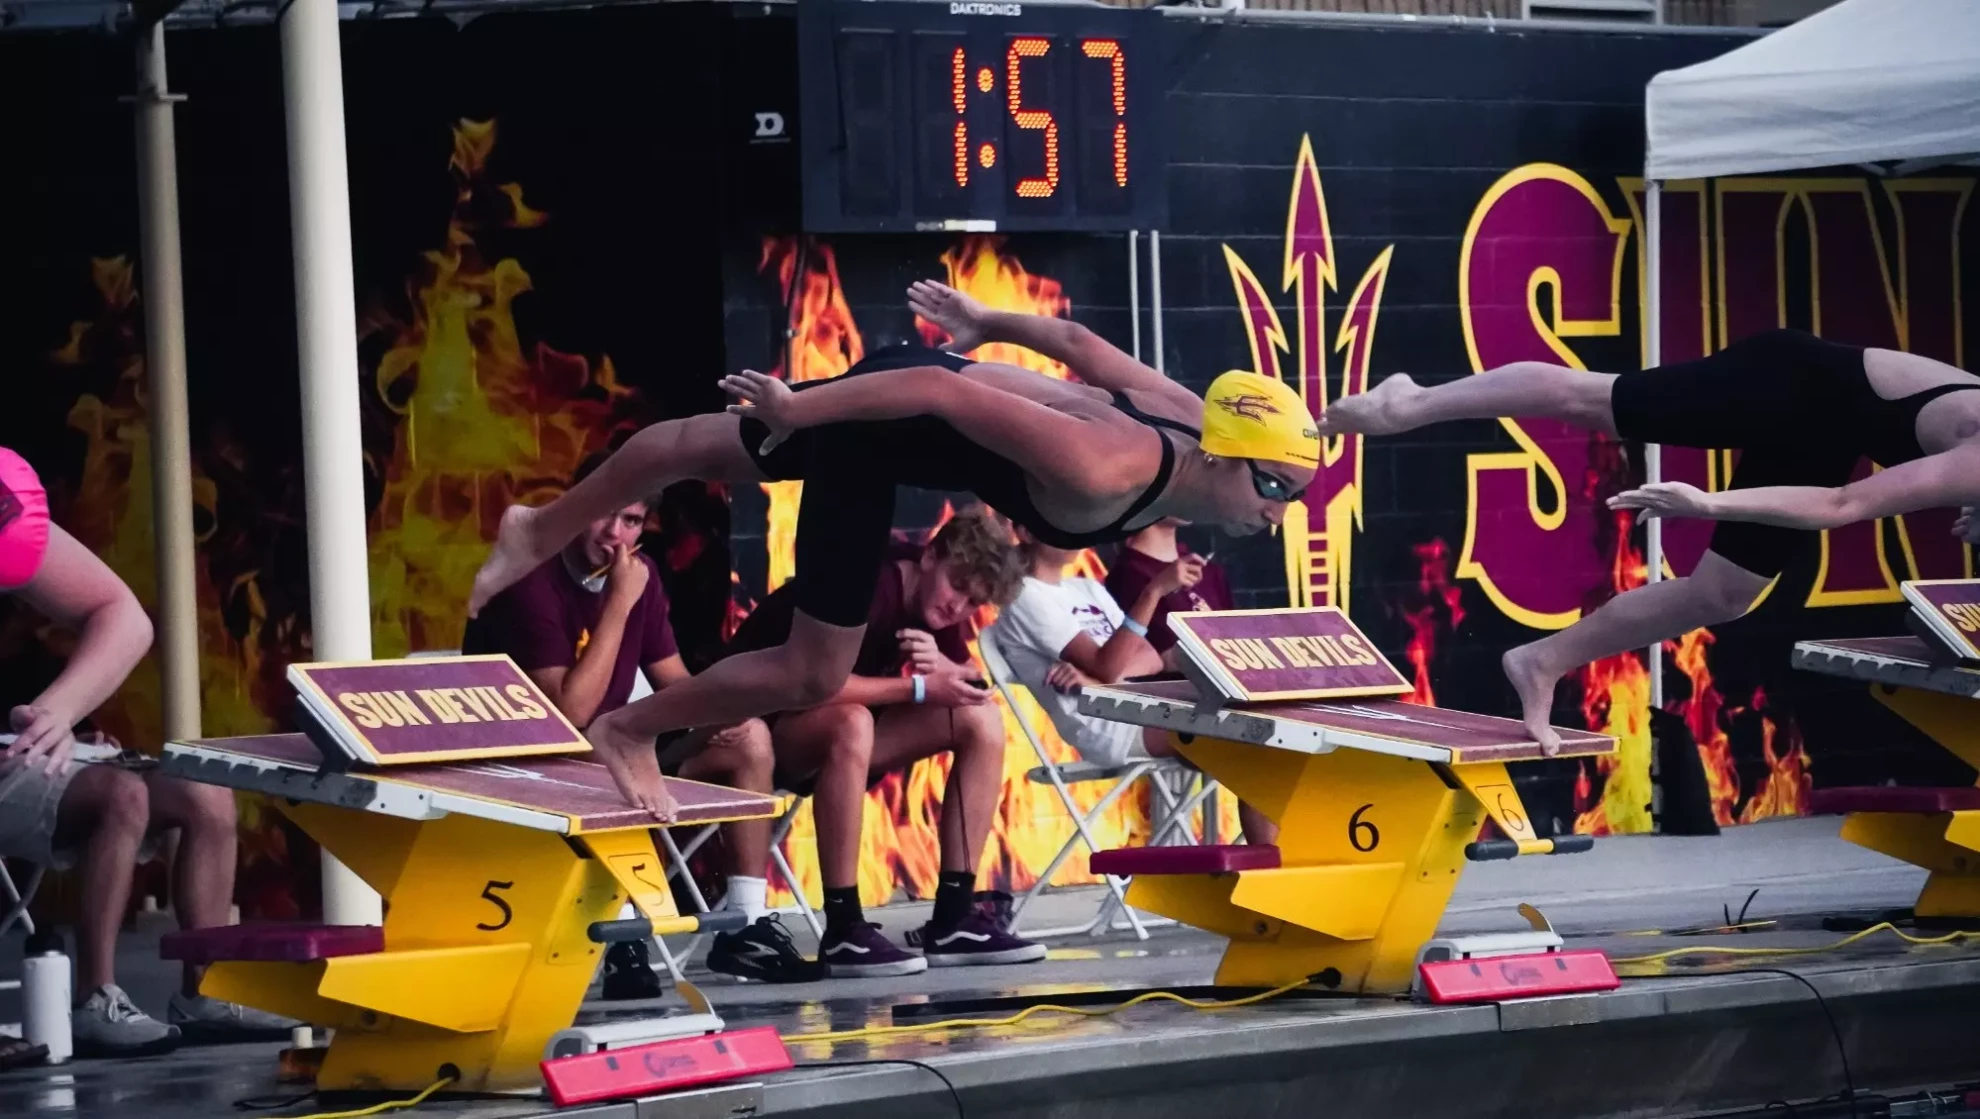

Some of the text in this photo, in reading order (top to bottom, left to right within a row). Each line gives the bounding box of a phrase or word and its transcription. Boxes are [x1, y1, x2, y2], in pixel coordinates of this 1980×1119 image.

[950, 2, 1021, 16] DAKTRONICS
[953, 39, 1127, 197] 1:57
[1942, 603, 1980, 632] SU
[1210, 633, 1377, 671] SUN DEVILS
[338, 684, 548, 728] SUN DEVILS
[1348, 804, 1380, 852] 6
[1497, 793, 1524, 831] 6
[476, 880, 514, 931] 5
